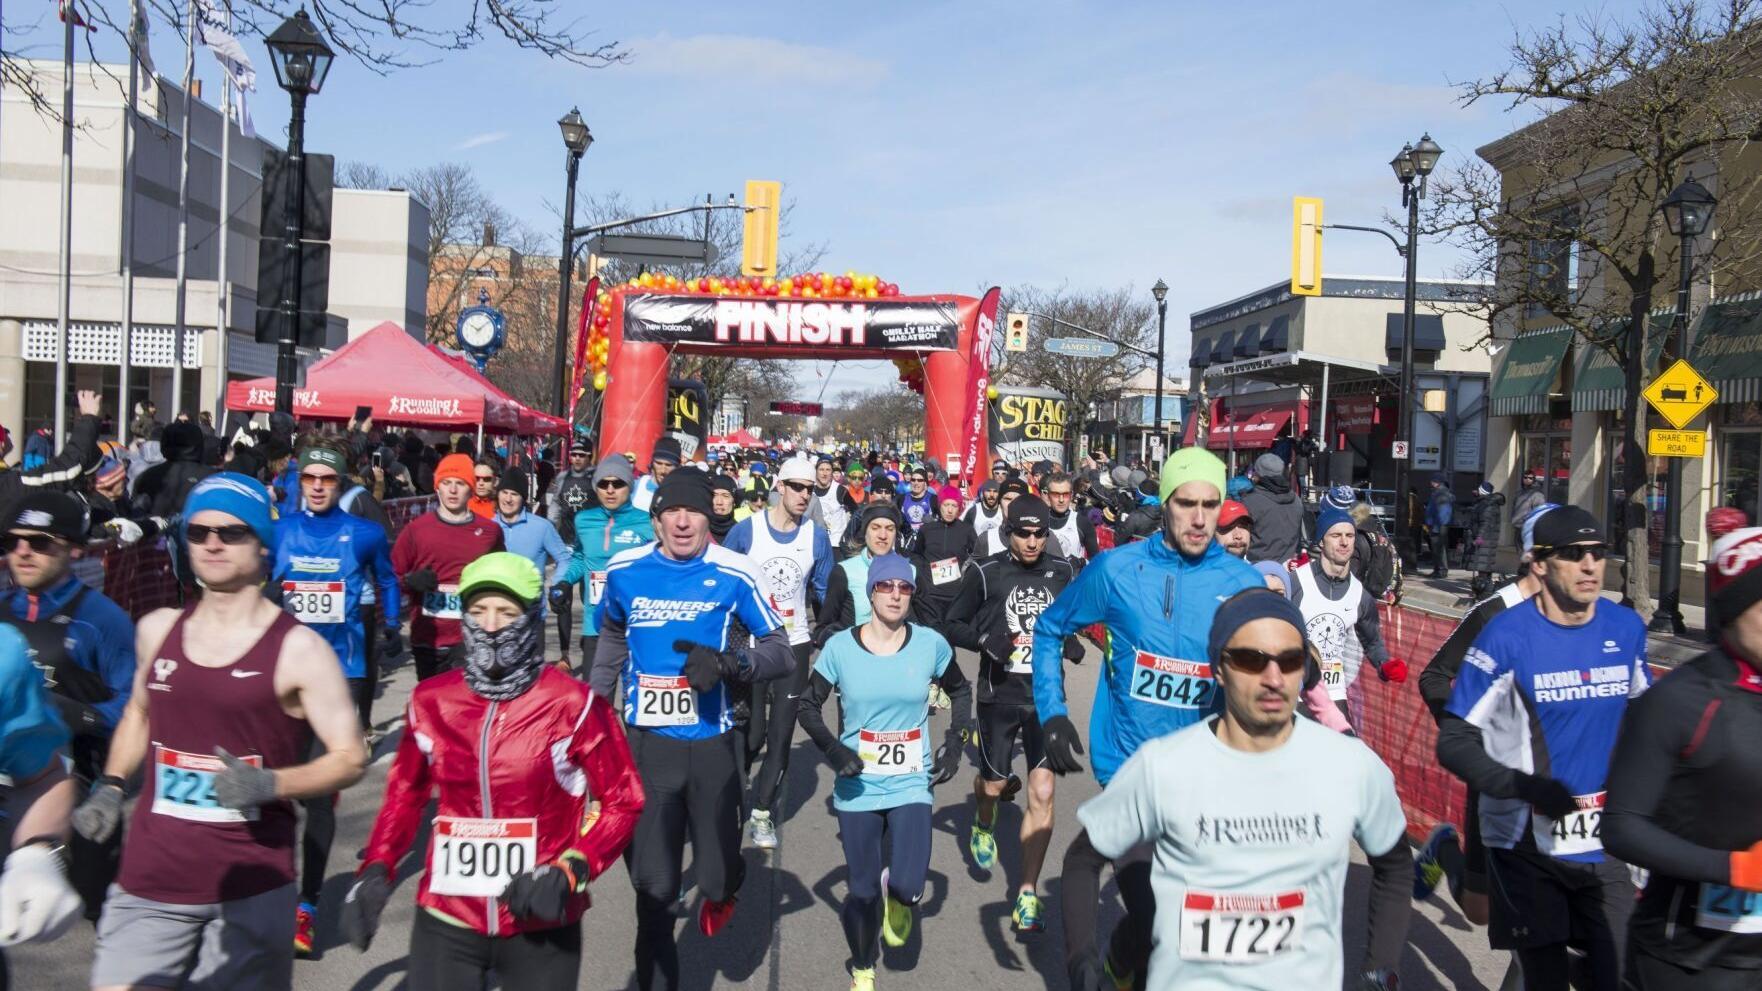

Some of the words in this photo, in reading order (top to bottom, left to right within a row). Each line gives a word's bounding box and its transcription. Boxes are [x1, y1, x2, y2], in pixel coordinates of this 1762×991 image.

[645, 323, 661, 331] new
[662, 324, 692, 332] balance
[714, 300, 866, 345] FINISH
[888, 333, 937, 342] MARATHON
[1059, 343, 1090, 351] JAMES
[1000, 395, 1066, 430] STAG
[1657, 433, 1681, 442] SHARE
[1685, 434, 1699, 443] THE
[1667, 444, 1687, 453] ROAD
[292, 593, 332, 613] 389
[631, 596, 720, 611] RUNNERS'
[640, 610, 699, 621] CHOICE
[1136, 669, 1211, 706] 2642
[643, 690, 691, 715] 206
[878, 743, 906, 766] 26
[1213, 813, 1307, 842] Running
[442, 841, 525, 879] 1900
[1192, 914, 1296, 953] 1722
